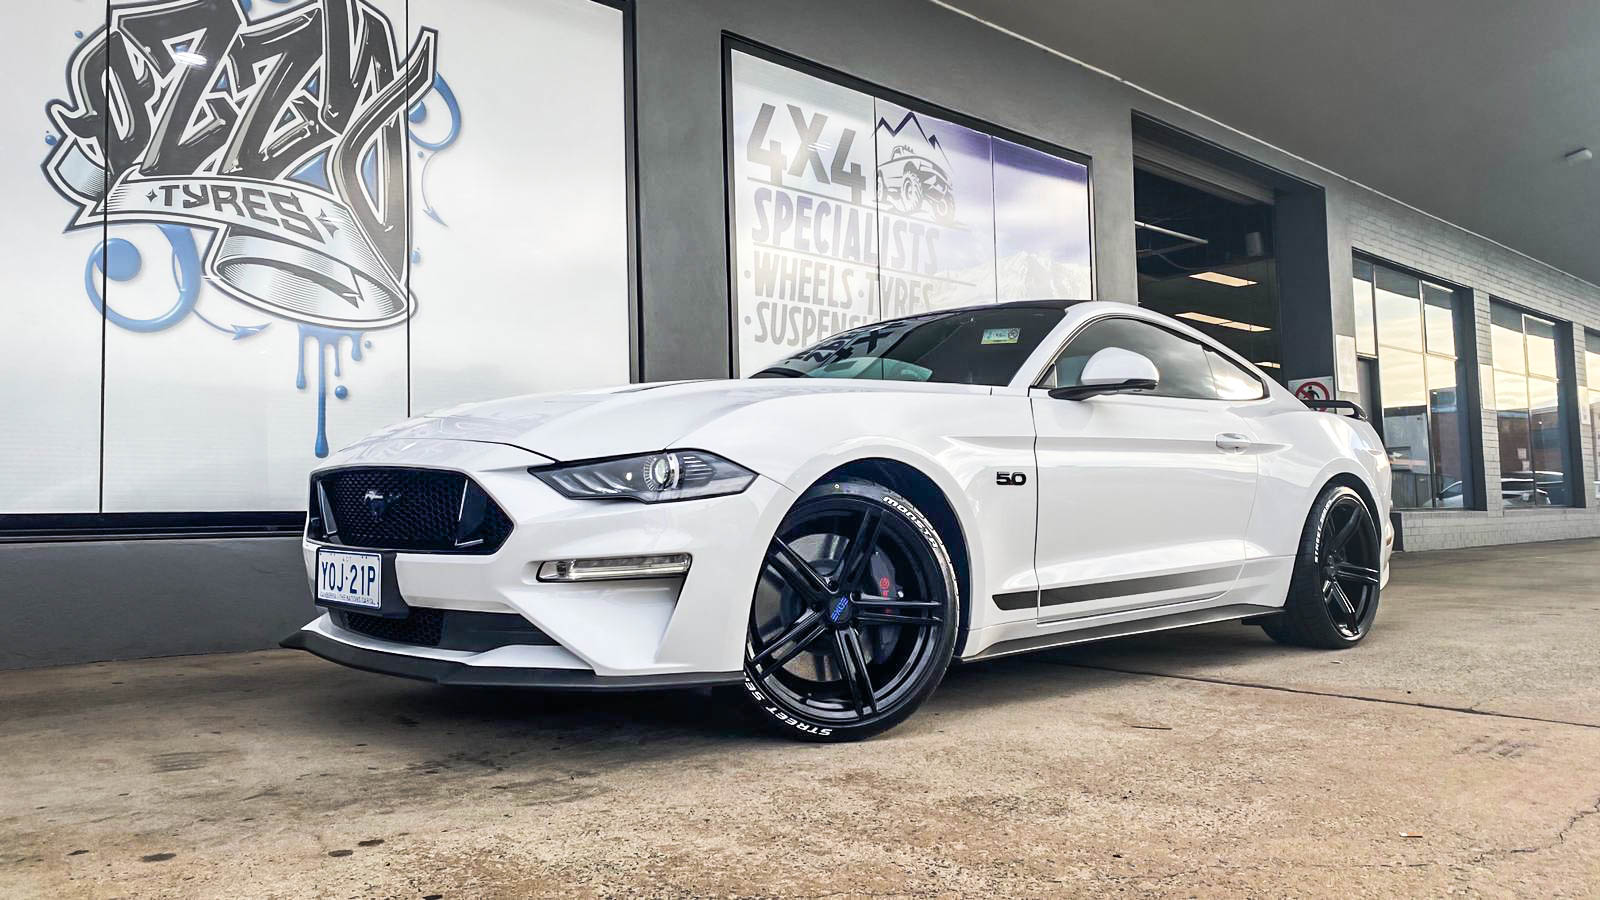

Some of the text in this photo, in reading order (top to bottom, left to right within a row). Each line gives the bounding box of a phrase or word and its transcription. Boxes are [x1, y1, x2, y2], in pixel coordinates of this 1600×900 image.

[158, 183, 326, 244] TYRES
[752, 187, 940, 276] SPECIALISTS
[753, 250, 854, 310] WHEELS
[765, 706, 833, 736] STREET
